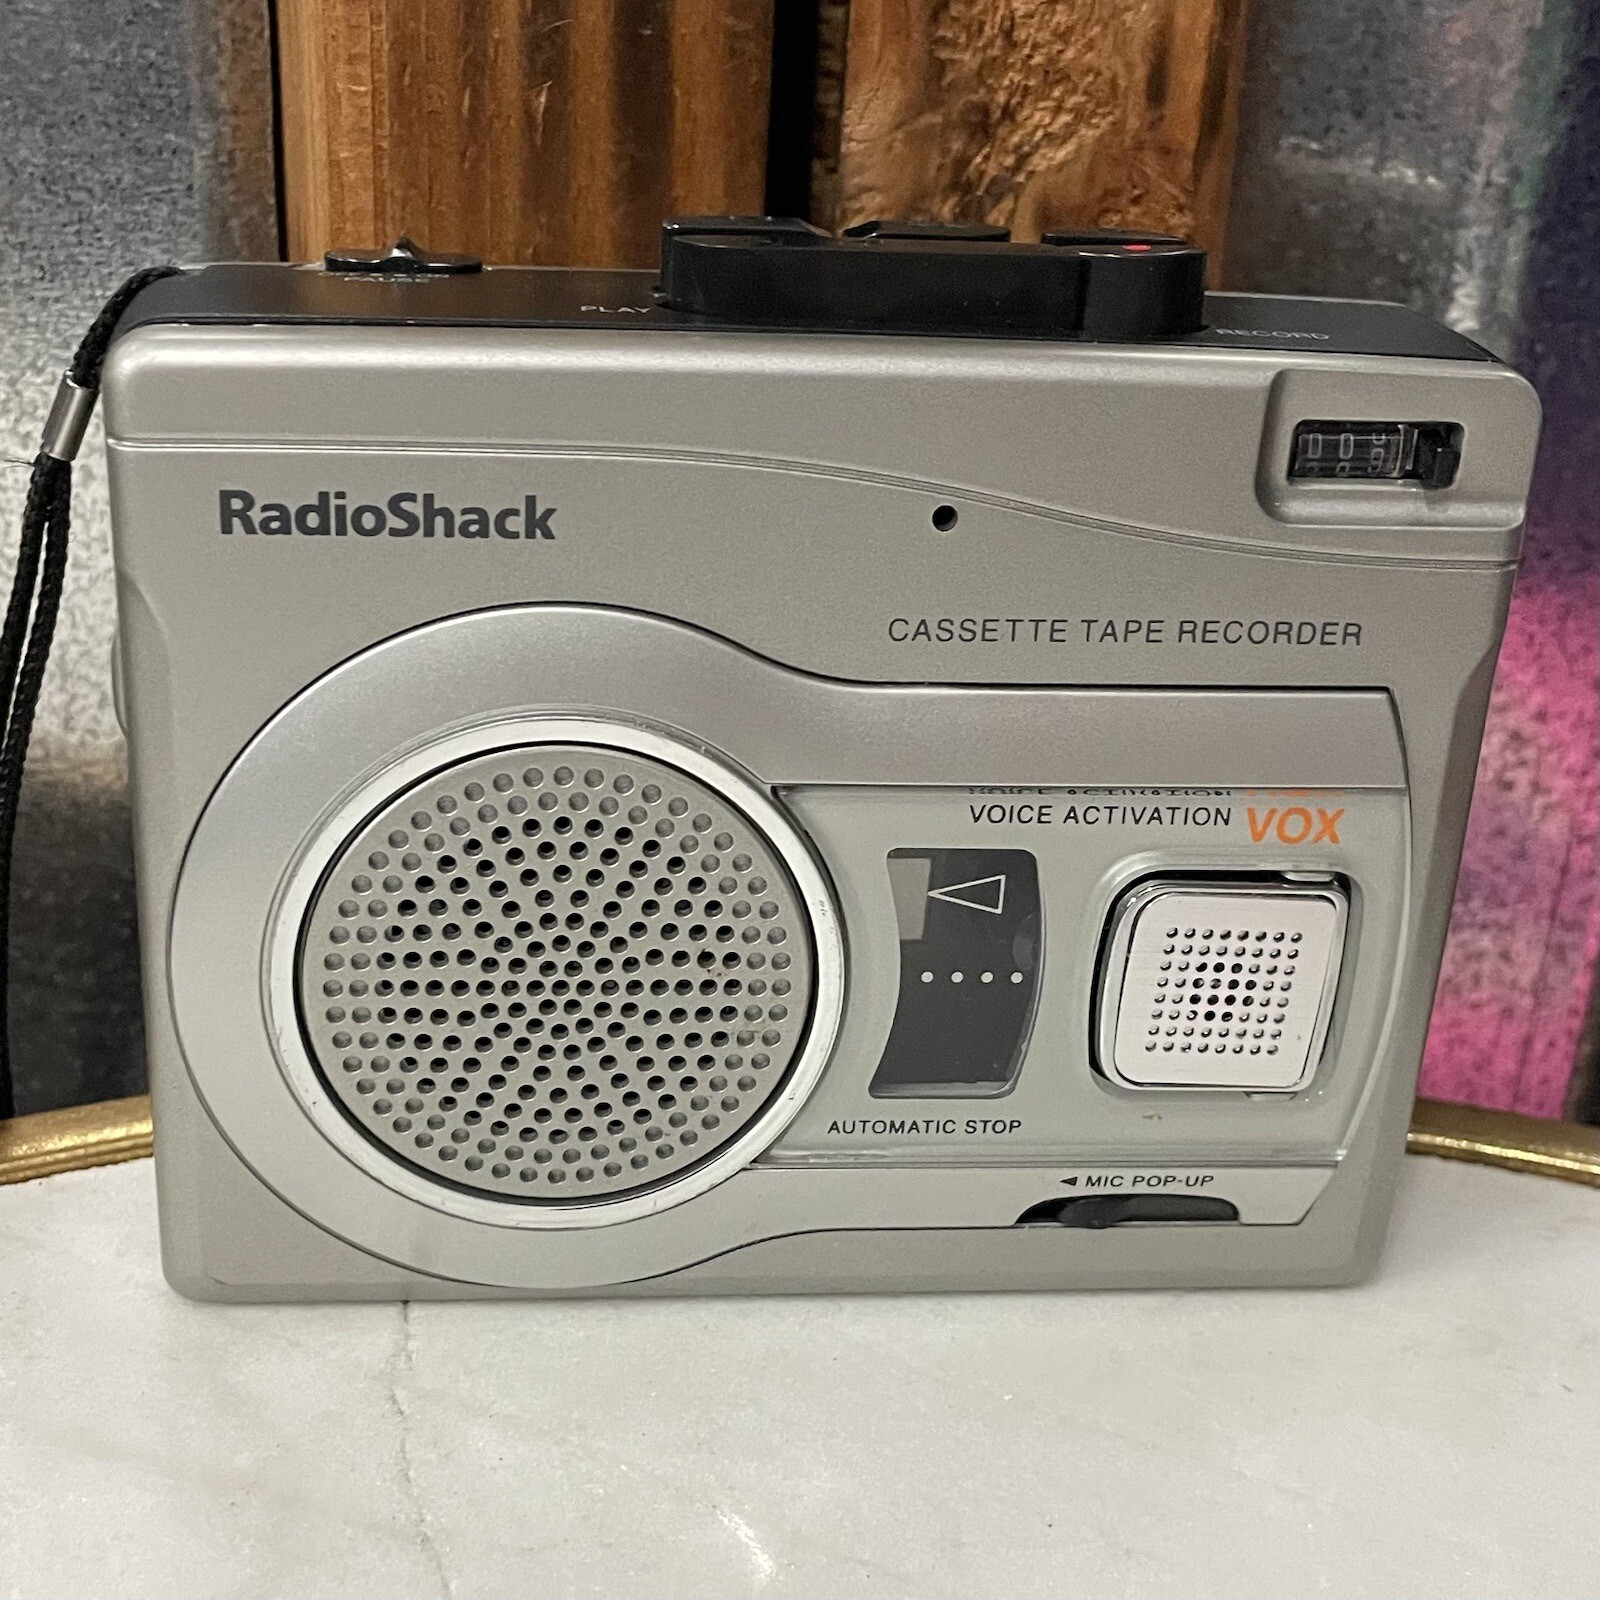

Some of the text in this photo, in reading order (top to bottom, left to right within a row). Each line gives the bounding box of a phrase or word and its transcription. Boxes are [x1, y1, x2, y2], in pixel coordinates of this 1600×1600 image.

[580, 305, 651, 313] PLAY
[1215, 328, 1330, 340] RECORD
[218, 489, 558, 540] RadioShack
[887, 617, 1363, 647] CASSETTE TAPE RECORDER
[968, 804, 1347, 845] VOICE ACTIVATION VOX
[826, 1118, 1023, 1135] AUTOMATIC STOP
[1084, 1174, 1215, 1188] MIC POP-UP
